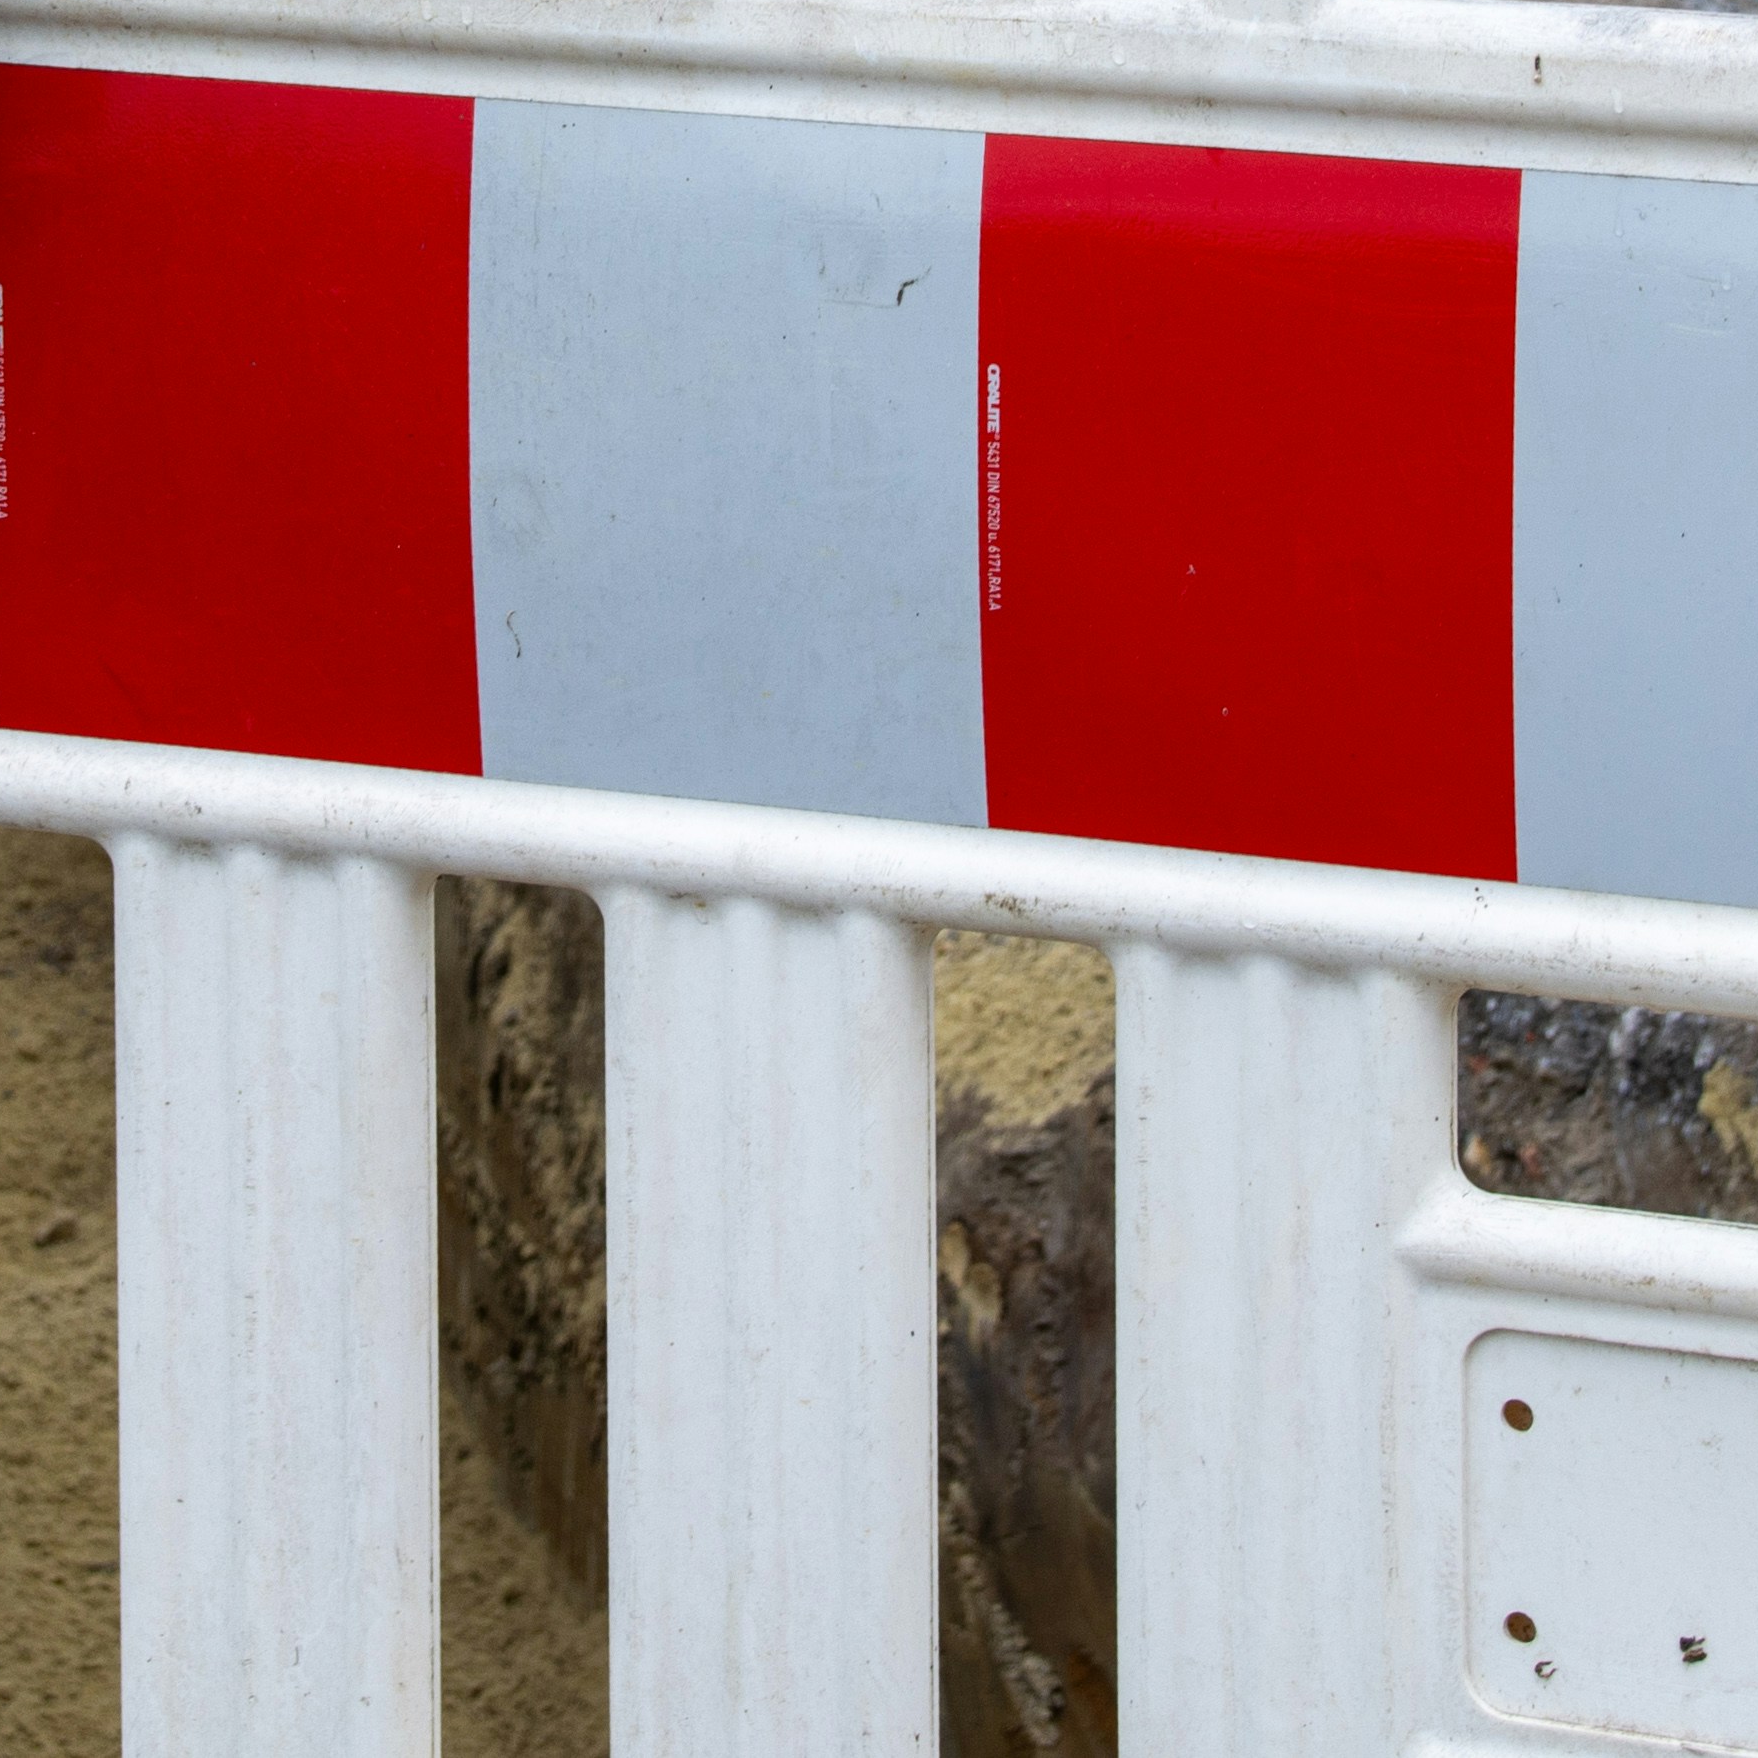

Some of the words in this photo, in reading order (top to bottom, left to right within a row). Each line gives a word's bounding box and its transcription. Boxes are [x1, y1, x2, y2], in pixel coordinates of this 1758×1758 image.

[986, 441, 1001, 469] 5431
[987, 471, 1001, 494] DIN
[987, 495, 1001, 531] 67520
[987, 532, 998, 543] u.
